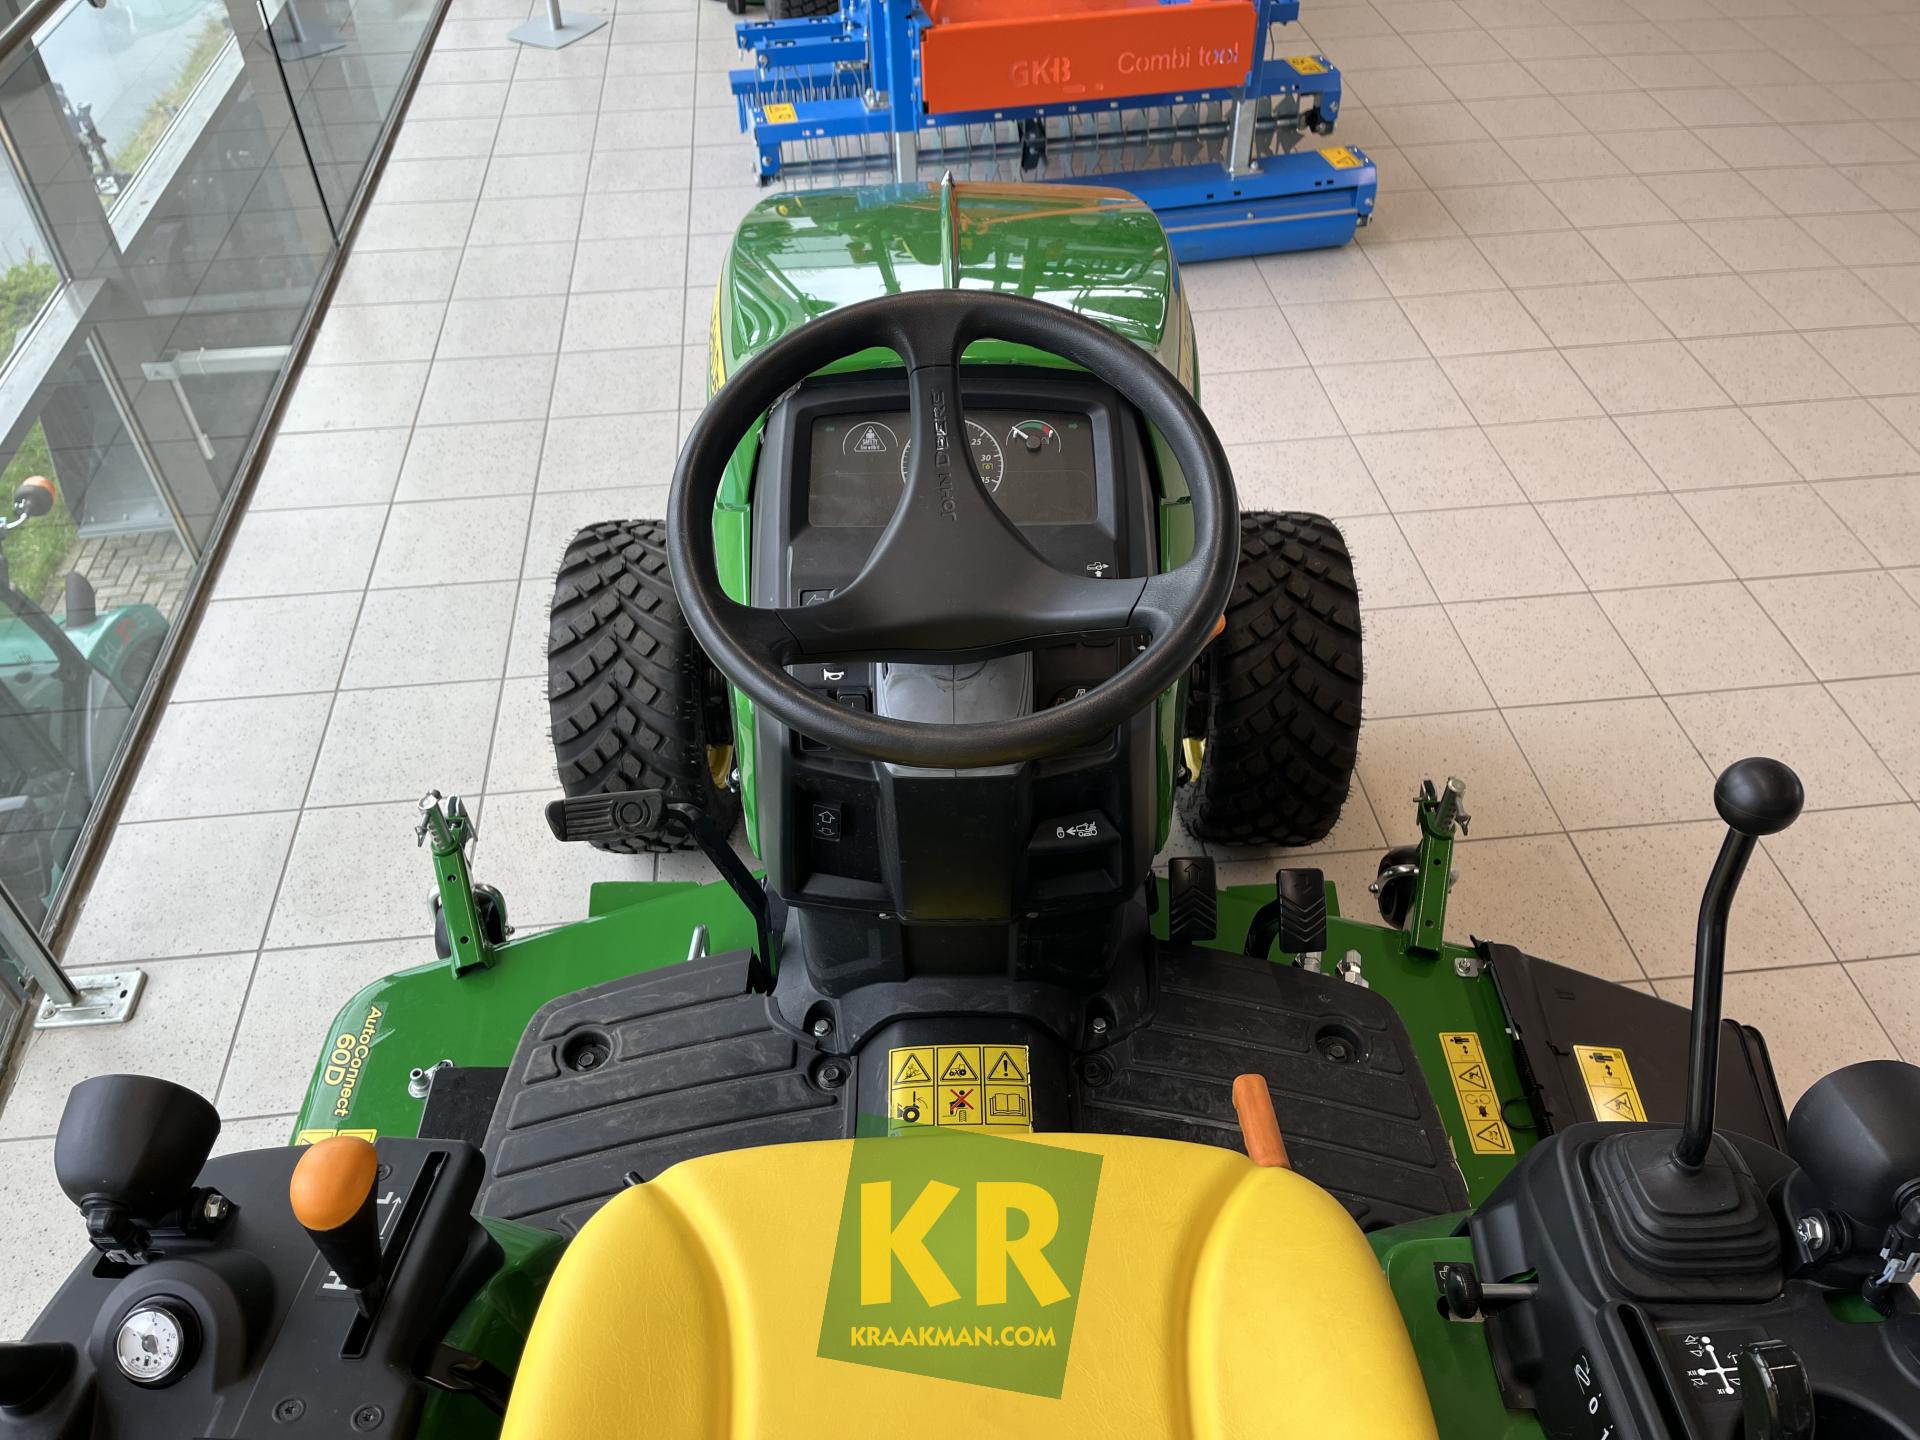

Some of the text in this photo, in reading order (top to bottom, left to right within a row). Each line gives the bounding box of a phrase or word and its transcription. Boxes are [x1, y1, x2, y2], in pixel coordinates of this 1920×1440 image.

[1118, 41, 1239, 75] Combi tool
[931, 391, 957, 522] JOHN DEERE
[970, 438, 982, 446] 25
[980, 454, 992, 462] 30
[324, 1033, 357, 1086] 60D
[334, 1005, 383, 1117] AutoConnect
